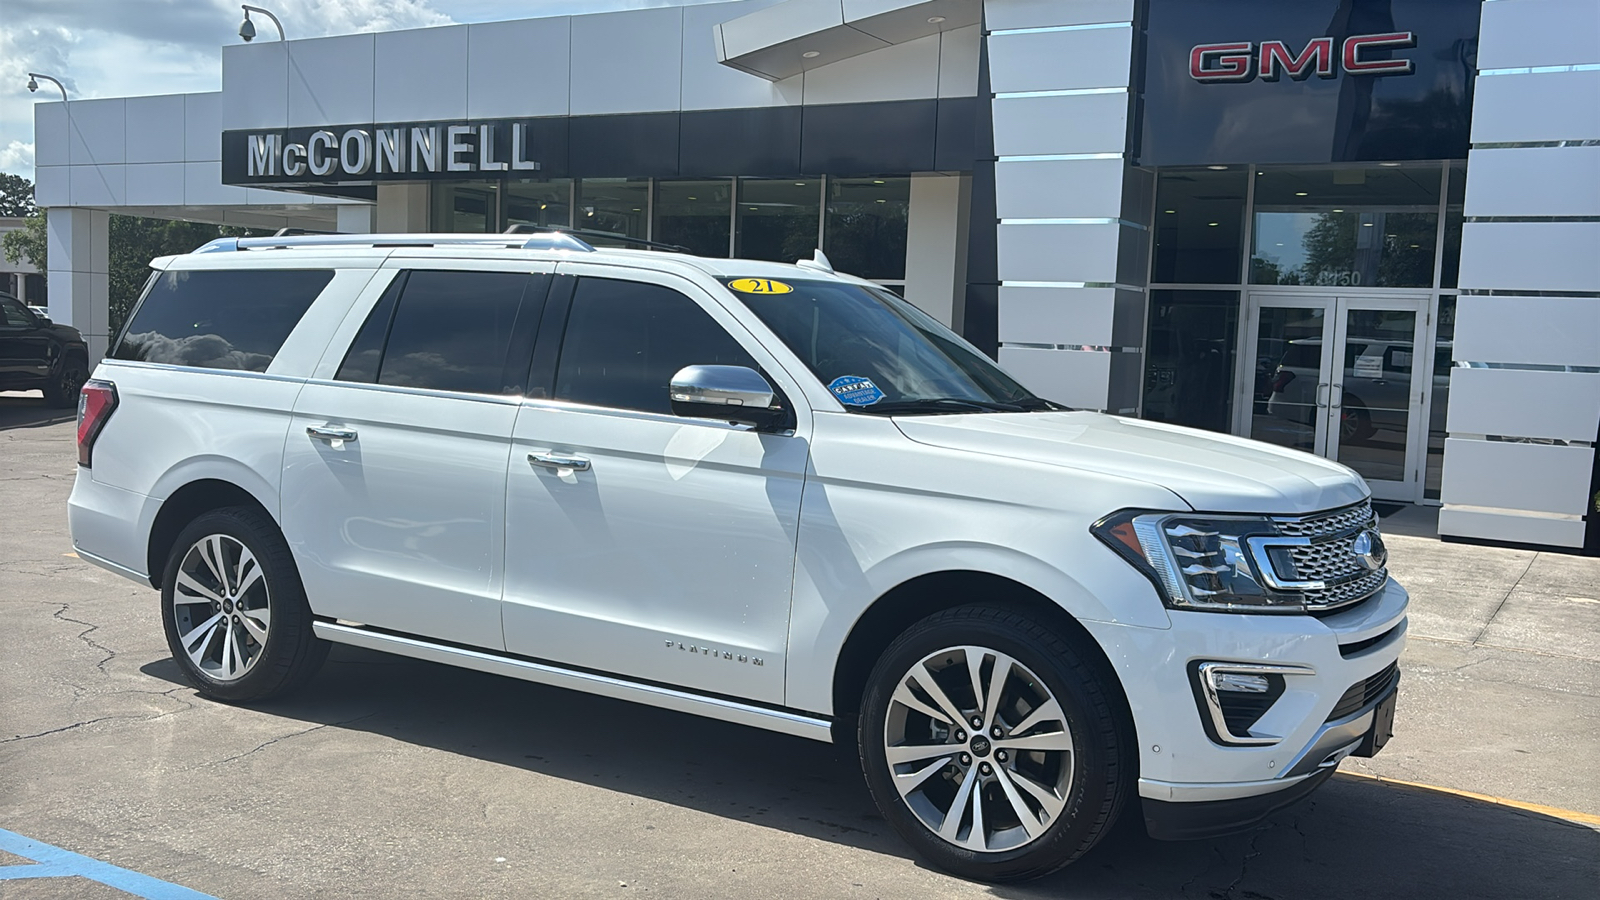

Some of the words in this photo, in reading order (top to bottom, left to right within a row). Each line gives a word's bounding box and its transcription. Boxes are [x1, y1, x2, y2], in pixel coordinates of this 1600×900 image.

[1189, 31, 1415, 81] GMC
[748, 279, 777, 293] 21
[664, 639, 764, 666] PLATINUM
